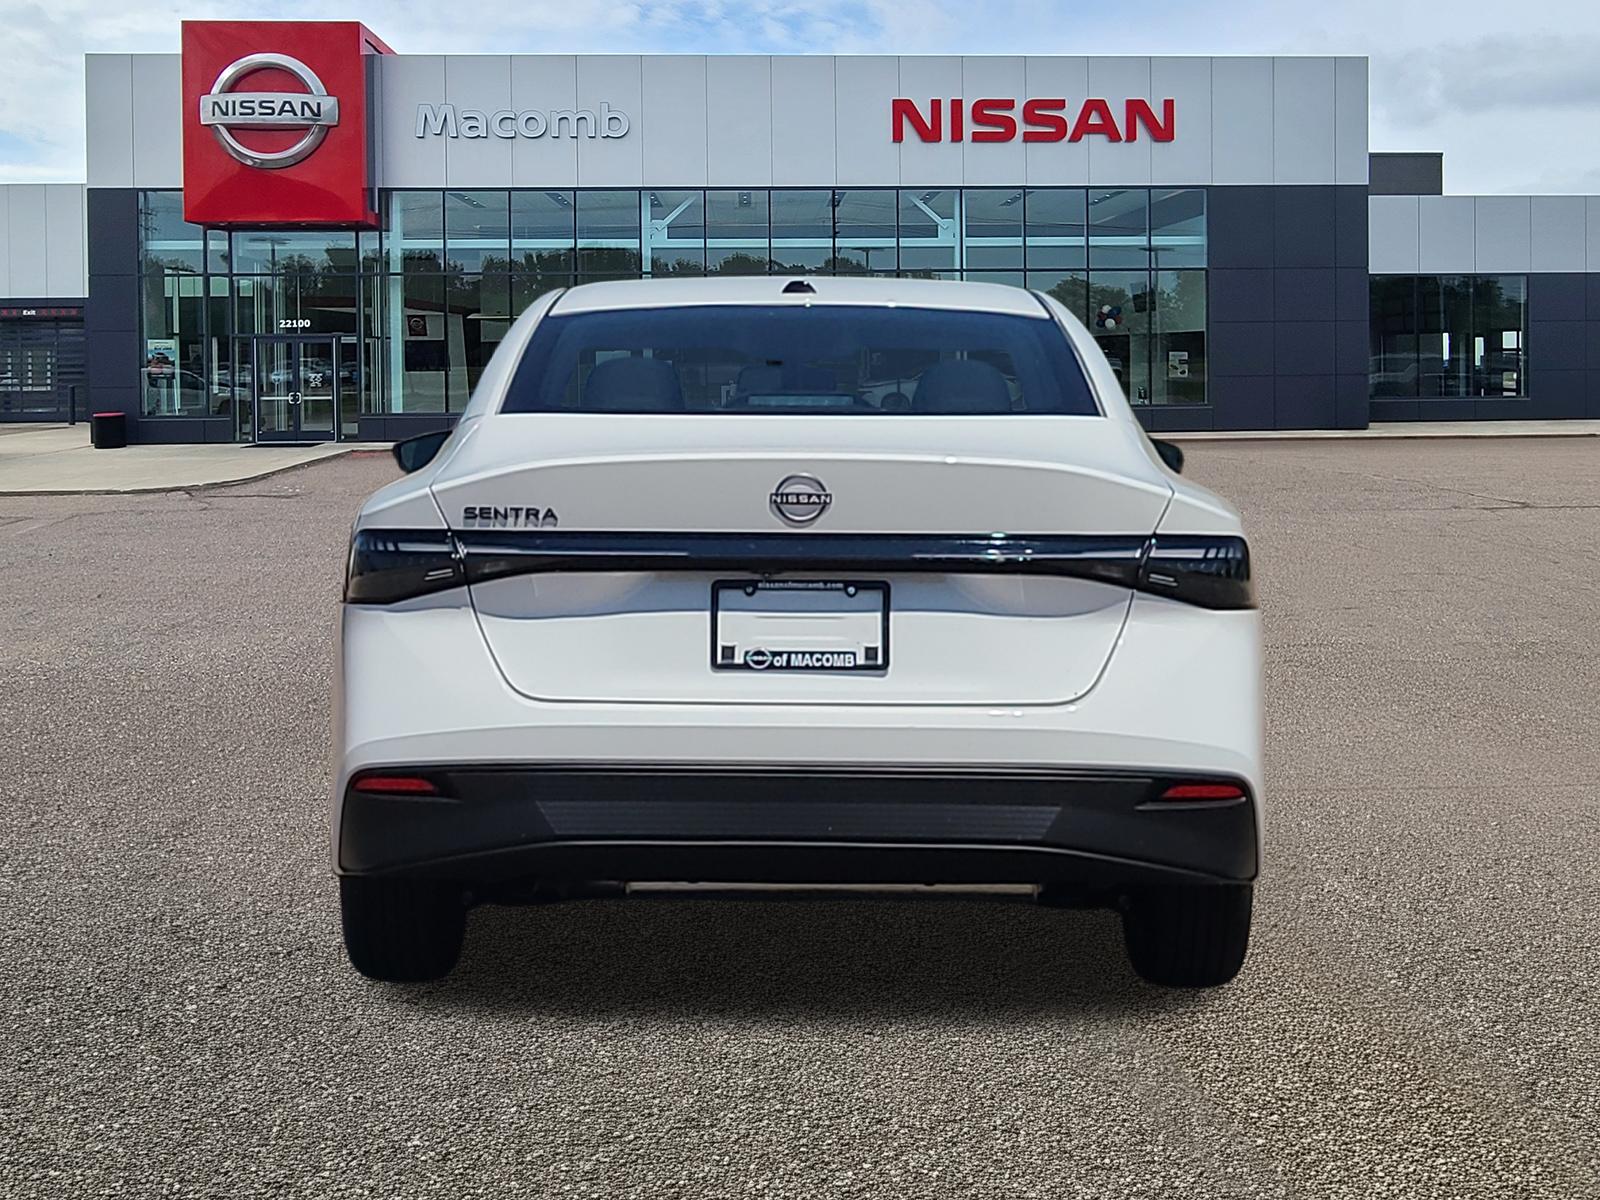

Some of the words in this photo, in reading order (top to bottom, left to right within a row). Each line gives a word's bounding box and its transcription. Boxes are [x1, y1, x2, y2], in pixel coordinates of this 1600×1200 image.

[211, 100, 322, 118] NISSAN
[415, 102, 630, 139] Macomb
[892, 98, 1175, 143] NISSAN
[279, 319, 311, 328] 22100
[771, 494, 831, 504] NISSAN
[463, 506, 559, 521] SENTRA
[773, 653, 789, 667] of
[790, 653, 855, 667] MACOMB
